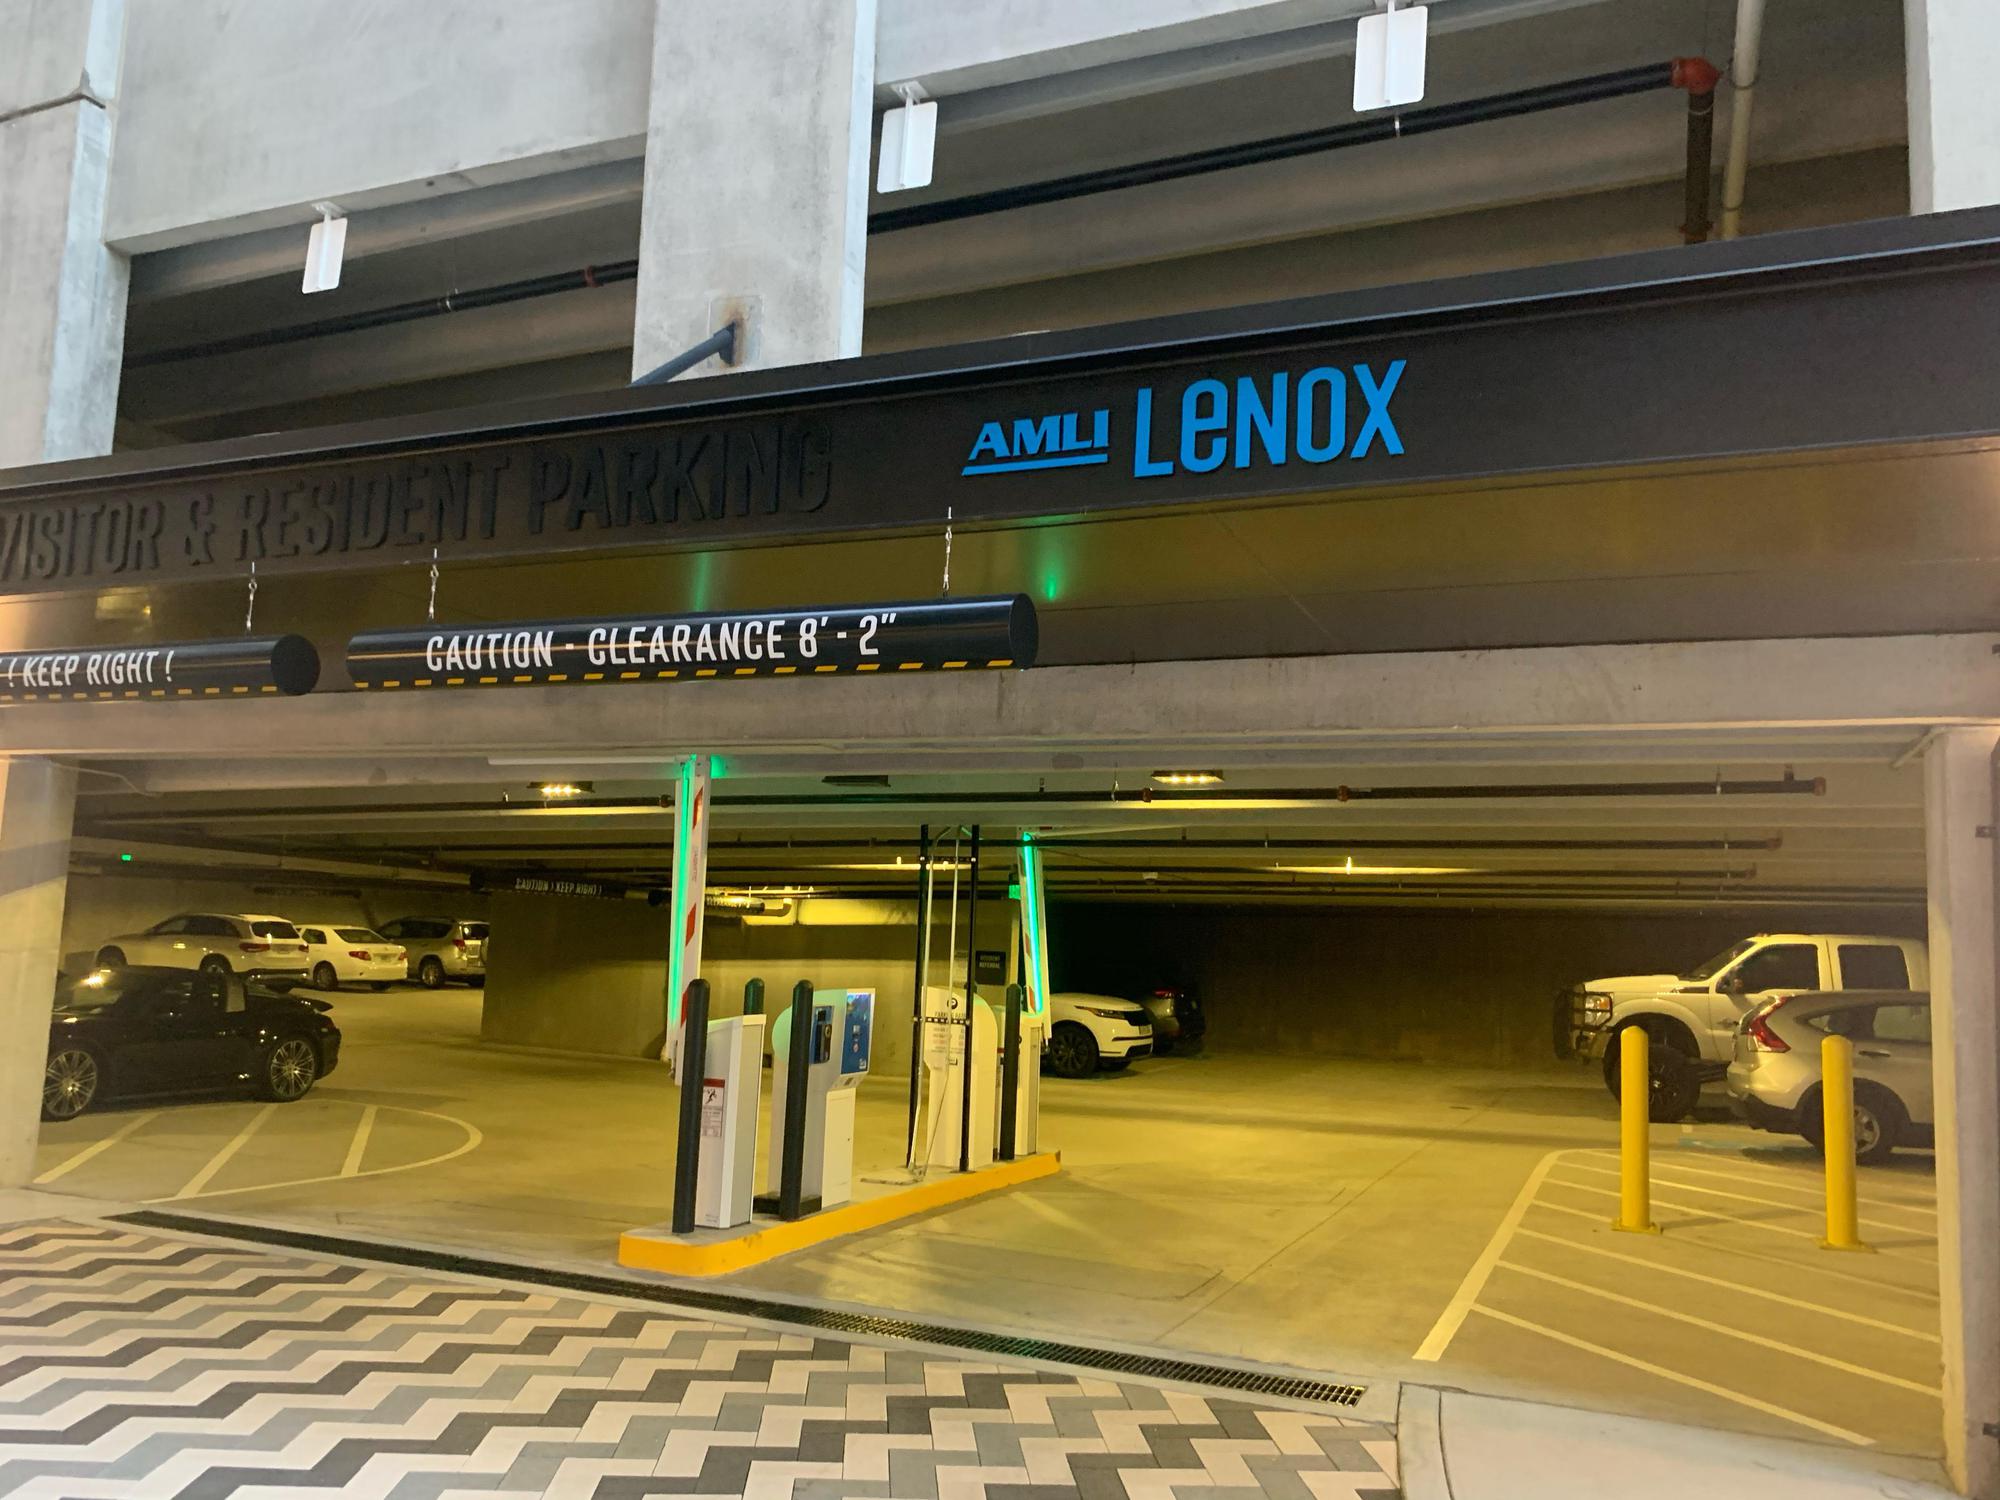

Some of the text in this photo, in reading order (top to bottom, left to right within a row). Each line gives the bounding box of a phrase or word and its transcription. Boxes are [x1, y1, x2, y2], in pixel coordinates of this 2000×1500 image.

[968, 409, 1109, 461] AMLI
[0, 422, 833, 582] VISITOR & RESIDENT PARKING
[23, 654, 80, 687] KEEP
[86, 650, 160, 686] RIGHT
[165, 649, 175, 682] !
[426, 630, 554, 672] CAUTION
[588, 619, 786, 666] CLEARANCE
[515, 877, 549, 892] CAUTION
